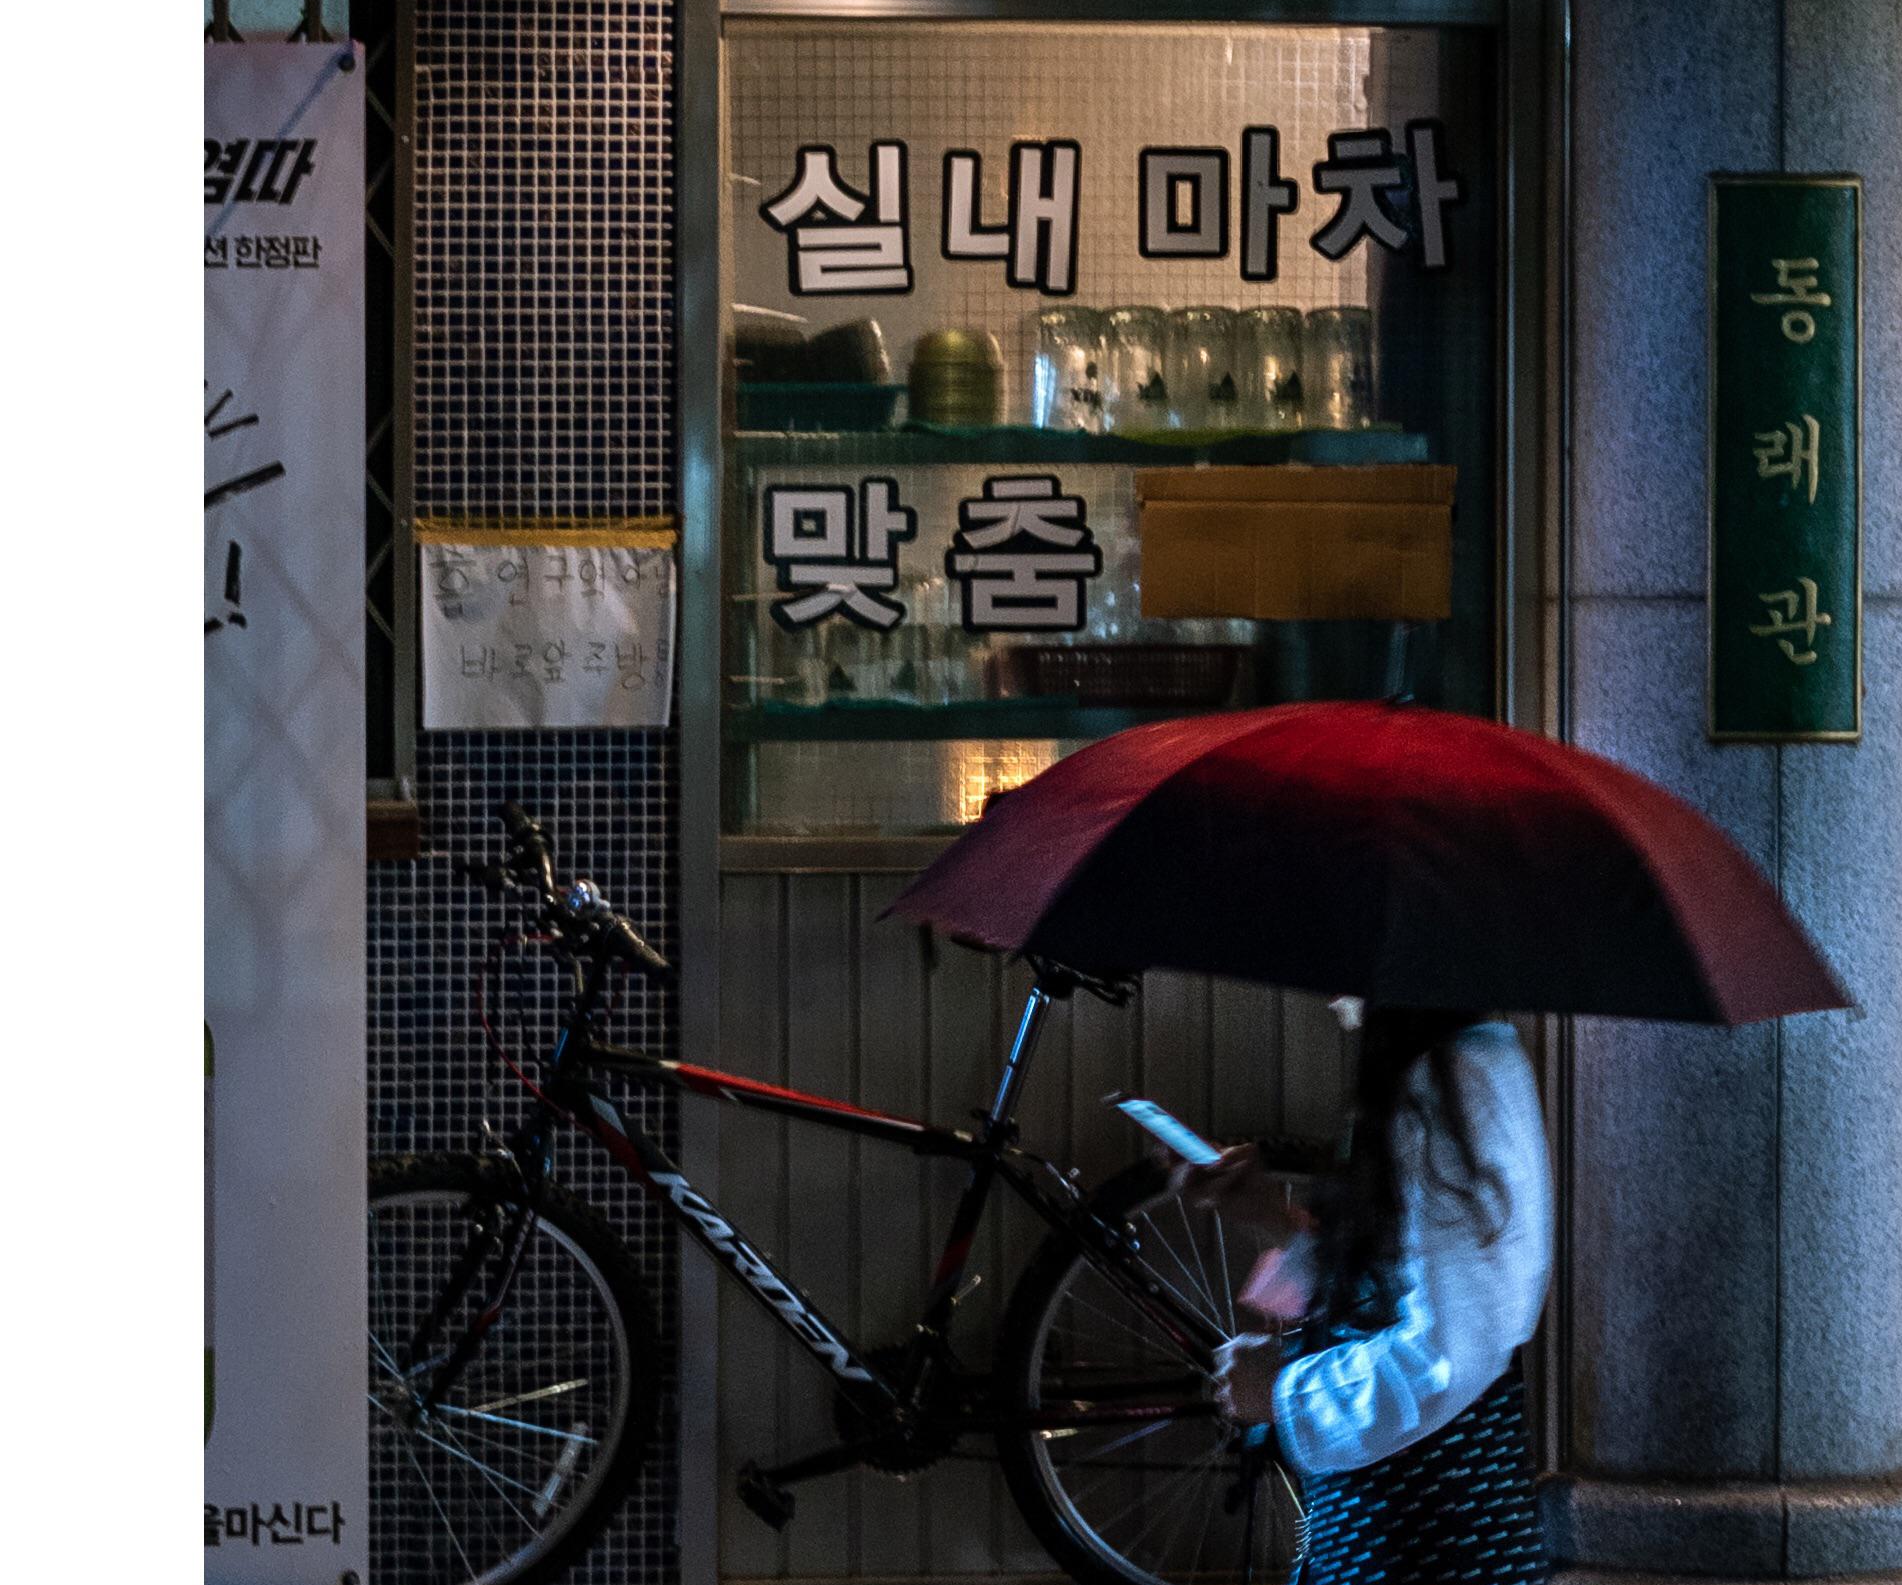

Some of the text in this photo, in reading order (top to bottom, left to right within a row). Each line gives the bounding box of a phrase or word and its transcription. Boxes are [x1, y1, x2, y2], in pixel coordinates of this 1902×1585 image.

[235, 234, 323, 269] 한정판
[759, 119, 1461, 297] 실내 마차
[1750, 257, 1832, 665] 동래관
[762, 473, 1103, 635] 맞춤
